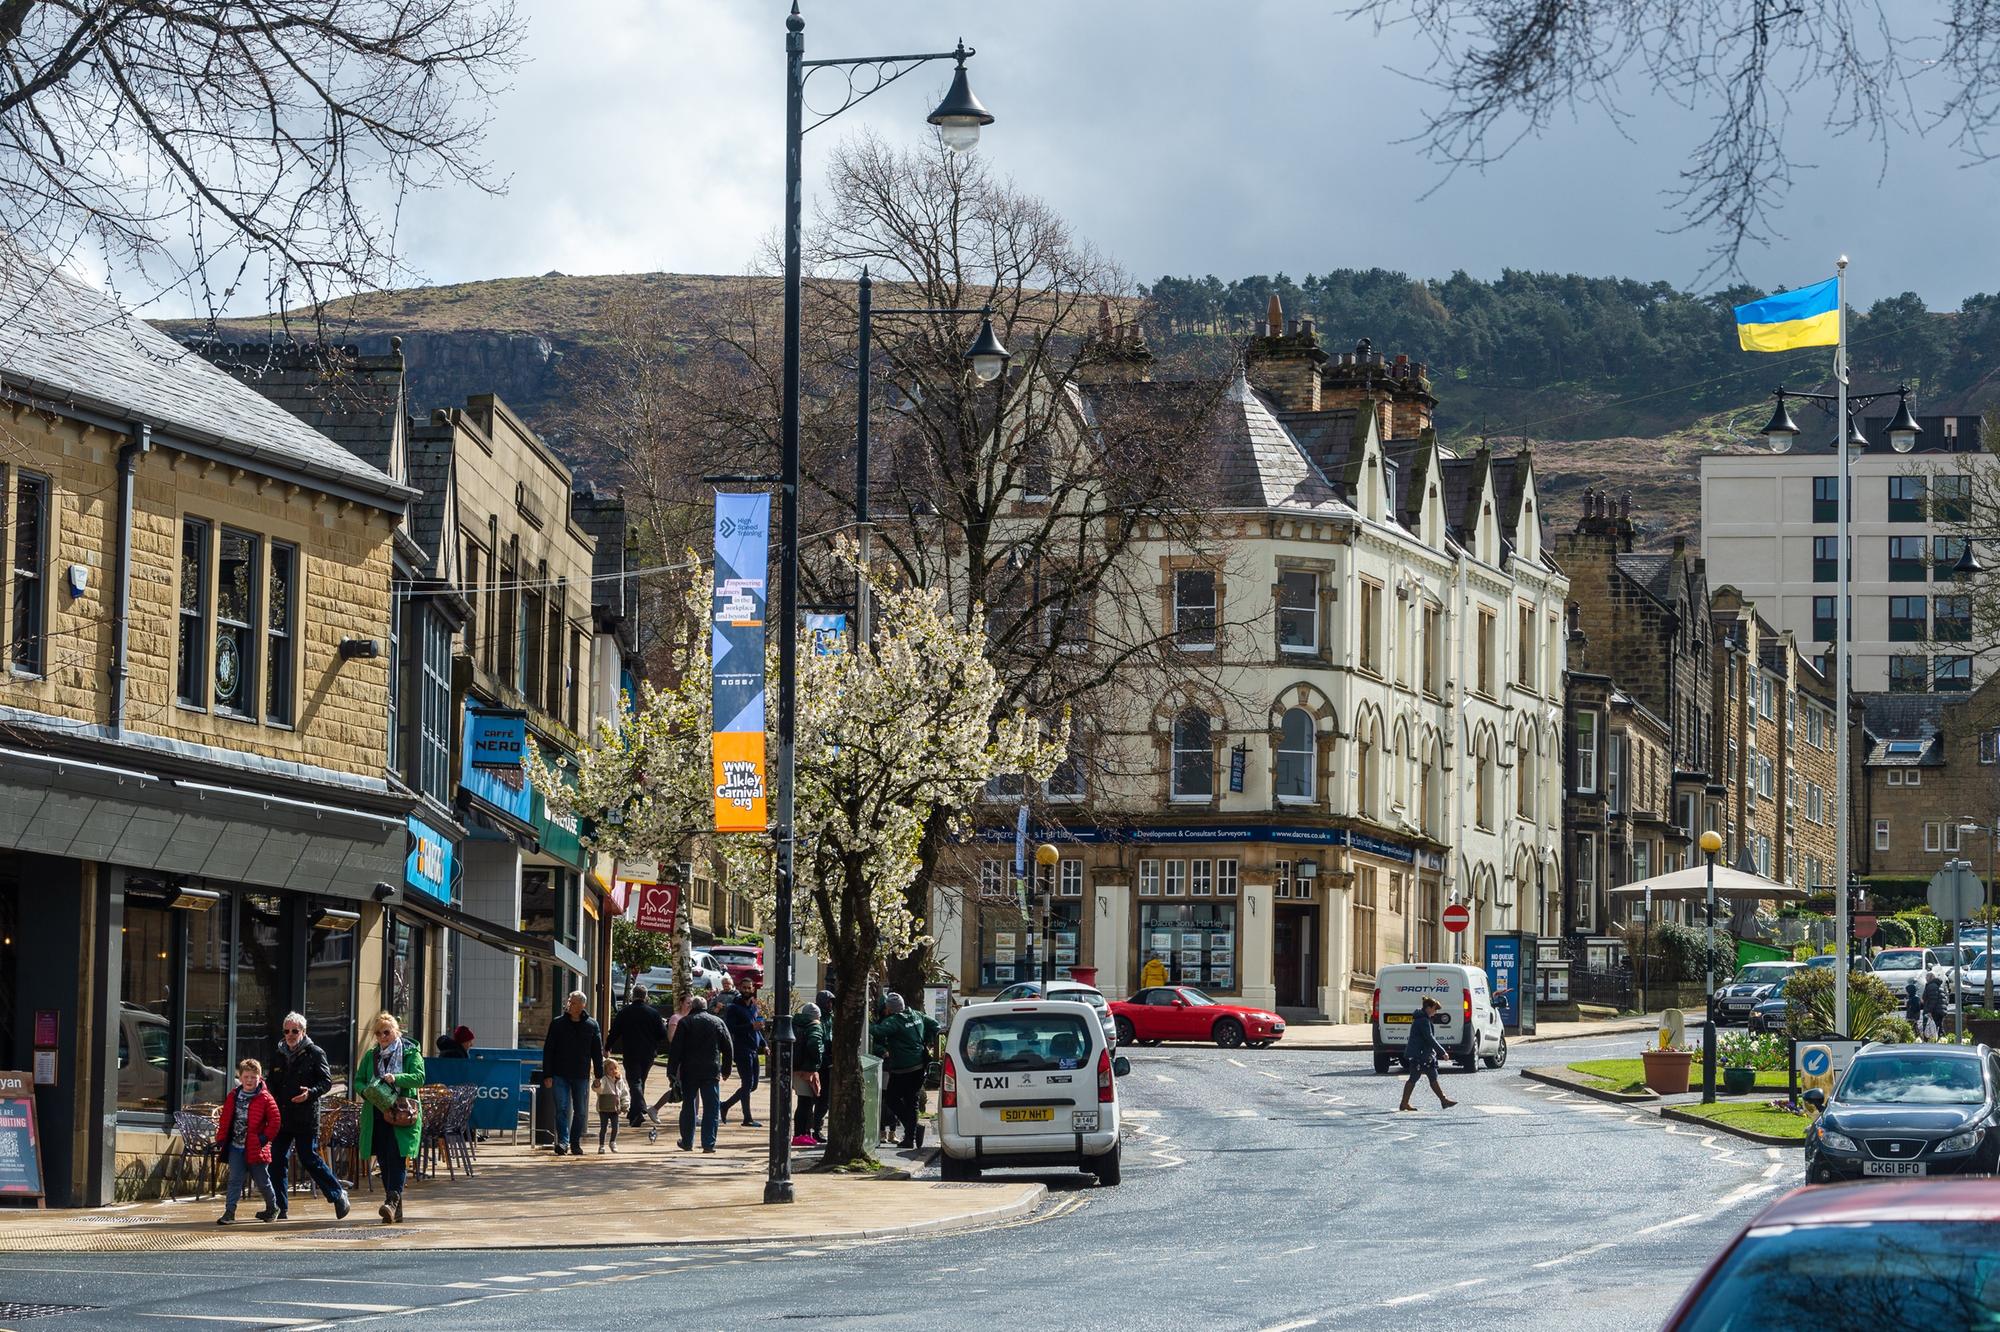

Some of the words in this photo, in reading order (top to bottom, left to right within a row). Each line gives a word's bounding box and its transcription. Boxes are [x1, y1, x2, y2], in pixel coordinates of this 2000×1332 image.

[475, 740, 521, 752] NERO
[725, 771, 762, 789] Ilkley
[716, 784, 763, 798] Carnival
[1137, 830, 1177, 839] Development
[1217, 829, 1247, 838] Surveyors
[1275, 830, 1326, 840] www.dacres.co.uk
[640, 921, 671, 929] Foundation
[1151, 919, 1174, 927] Dacre
[1196, 919, 1224, 929] Hartley
[1490, 960, 1502, 968] FOR
[1503, 960, 1515, 968] YOU
[1400, 985, 1450, 993] PROTYRE
[973, 1076, 1009, 1090] TAXI
[1005, 1110, 1027, 1120] SD17
[1029, 1109, 1048, 1120] NHT
[1870, 1162, 1895, 1173] GK61
[1897, 1162, 1919, 1174] BFO
